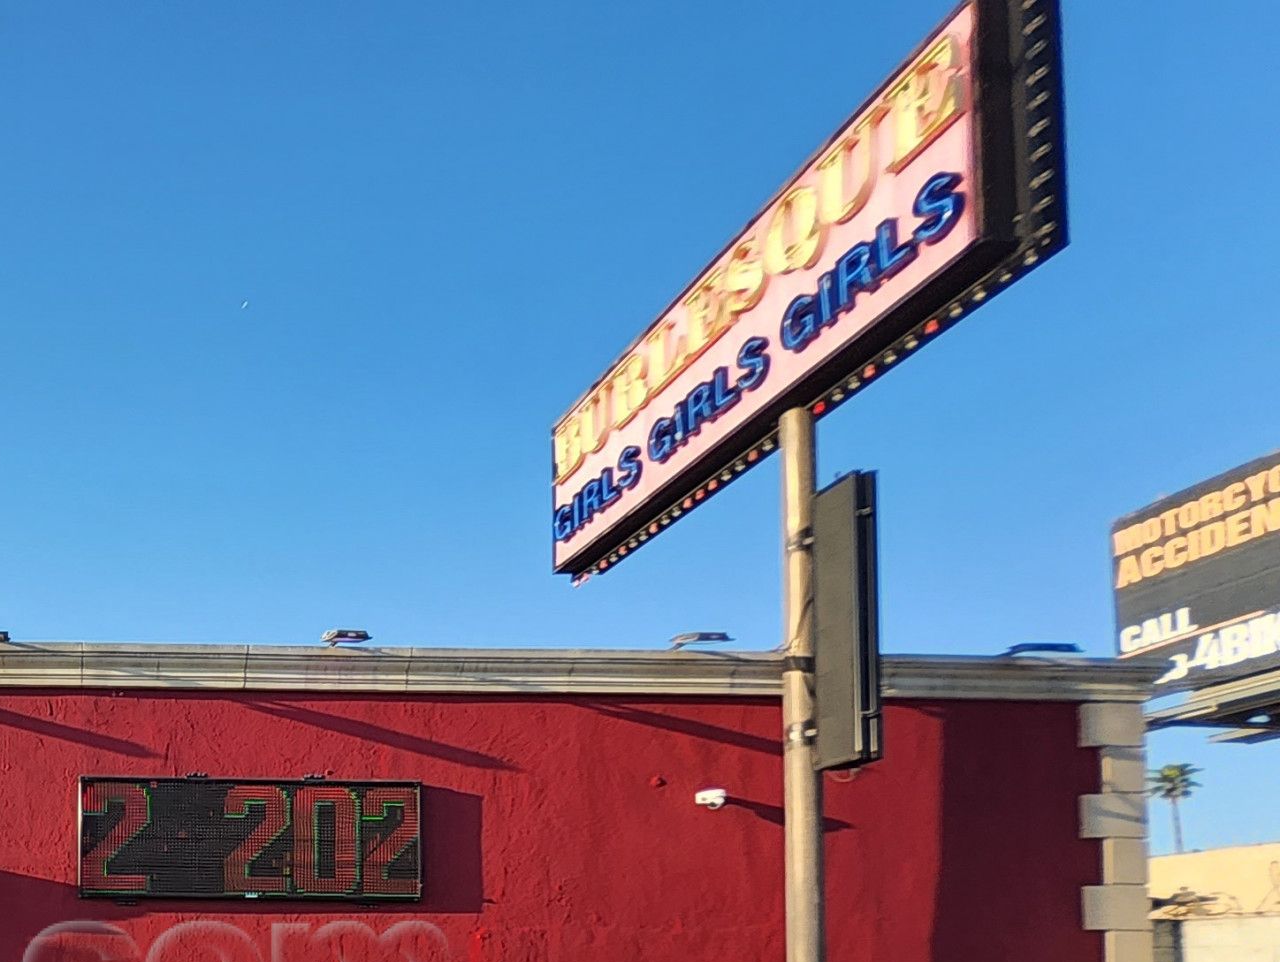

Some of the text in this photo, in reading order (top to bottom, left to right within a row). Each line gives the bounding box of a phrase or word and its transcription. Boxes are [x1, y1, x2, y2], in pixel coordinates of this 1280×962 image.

[554, 33, 966, 485] BURLESQUE
[554, 171, 965, 541] GIRLS GIRLS GIRLS
[1121, 607, 1199, 653] CALL
